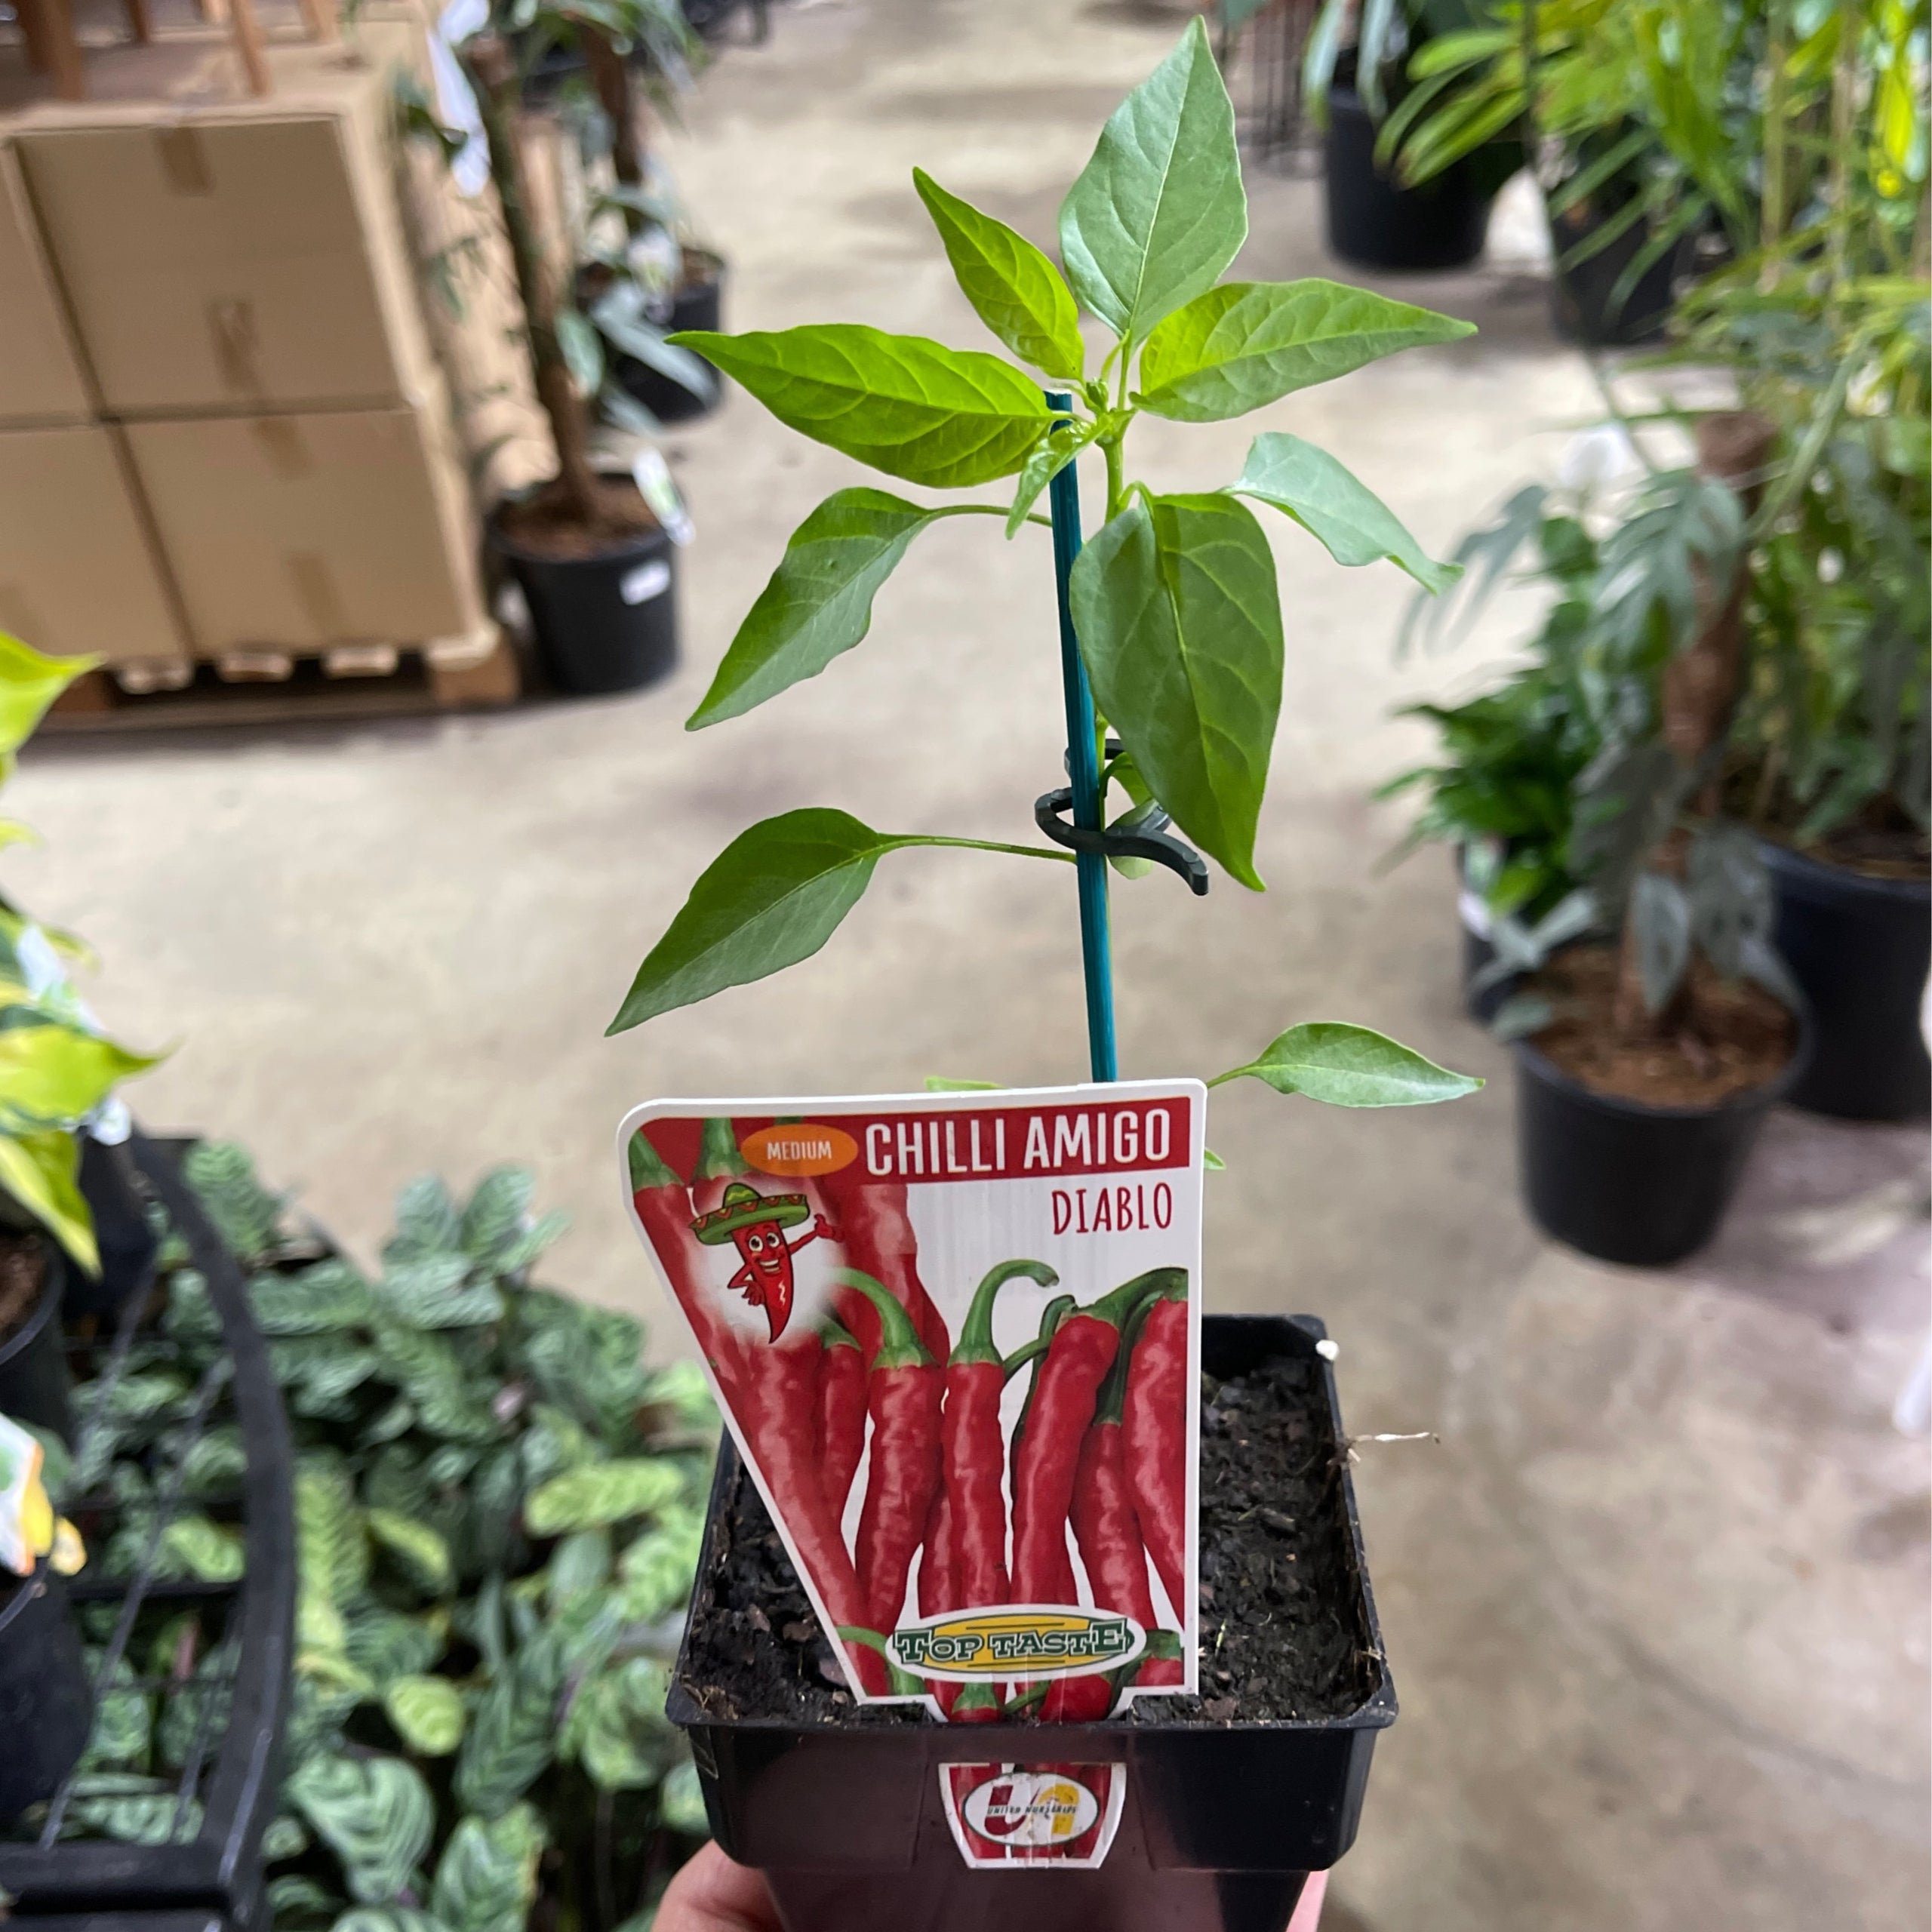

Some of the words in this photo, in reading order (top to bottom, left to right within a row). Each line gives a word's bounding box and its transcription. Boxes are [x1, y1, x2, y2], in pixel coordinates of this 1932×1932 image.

[766, 1140, 832, 1161] MEDIUM
[866, 1118, 1005, 1177] CHILLI
[1023, 1108, 1171, 1169] AMIGO
[1051, 1182, 1173, 1235] DIABLO
[893, 1629, 984, 1664] TOP
[989, 1618, 1128, 1660] TASTE
